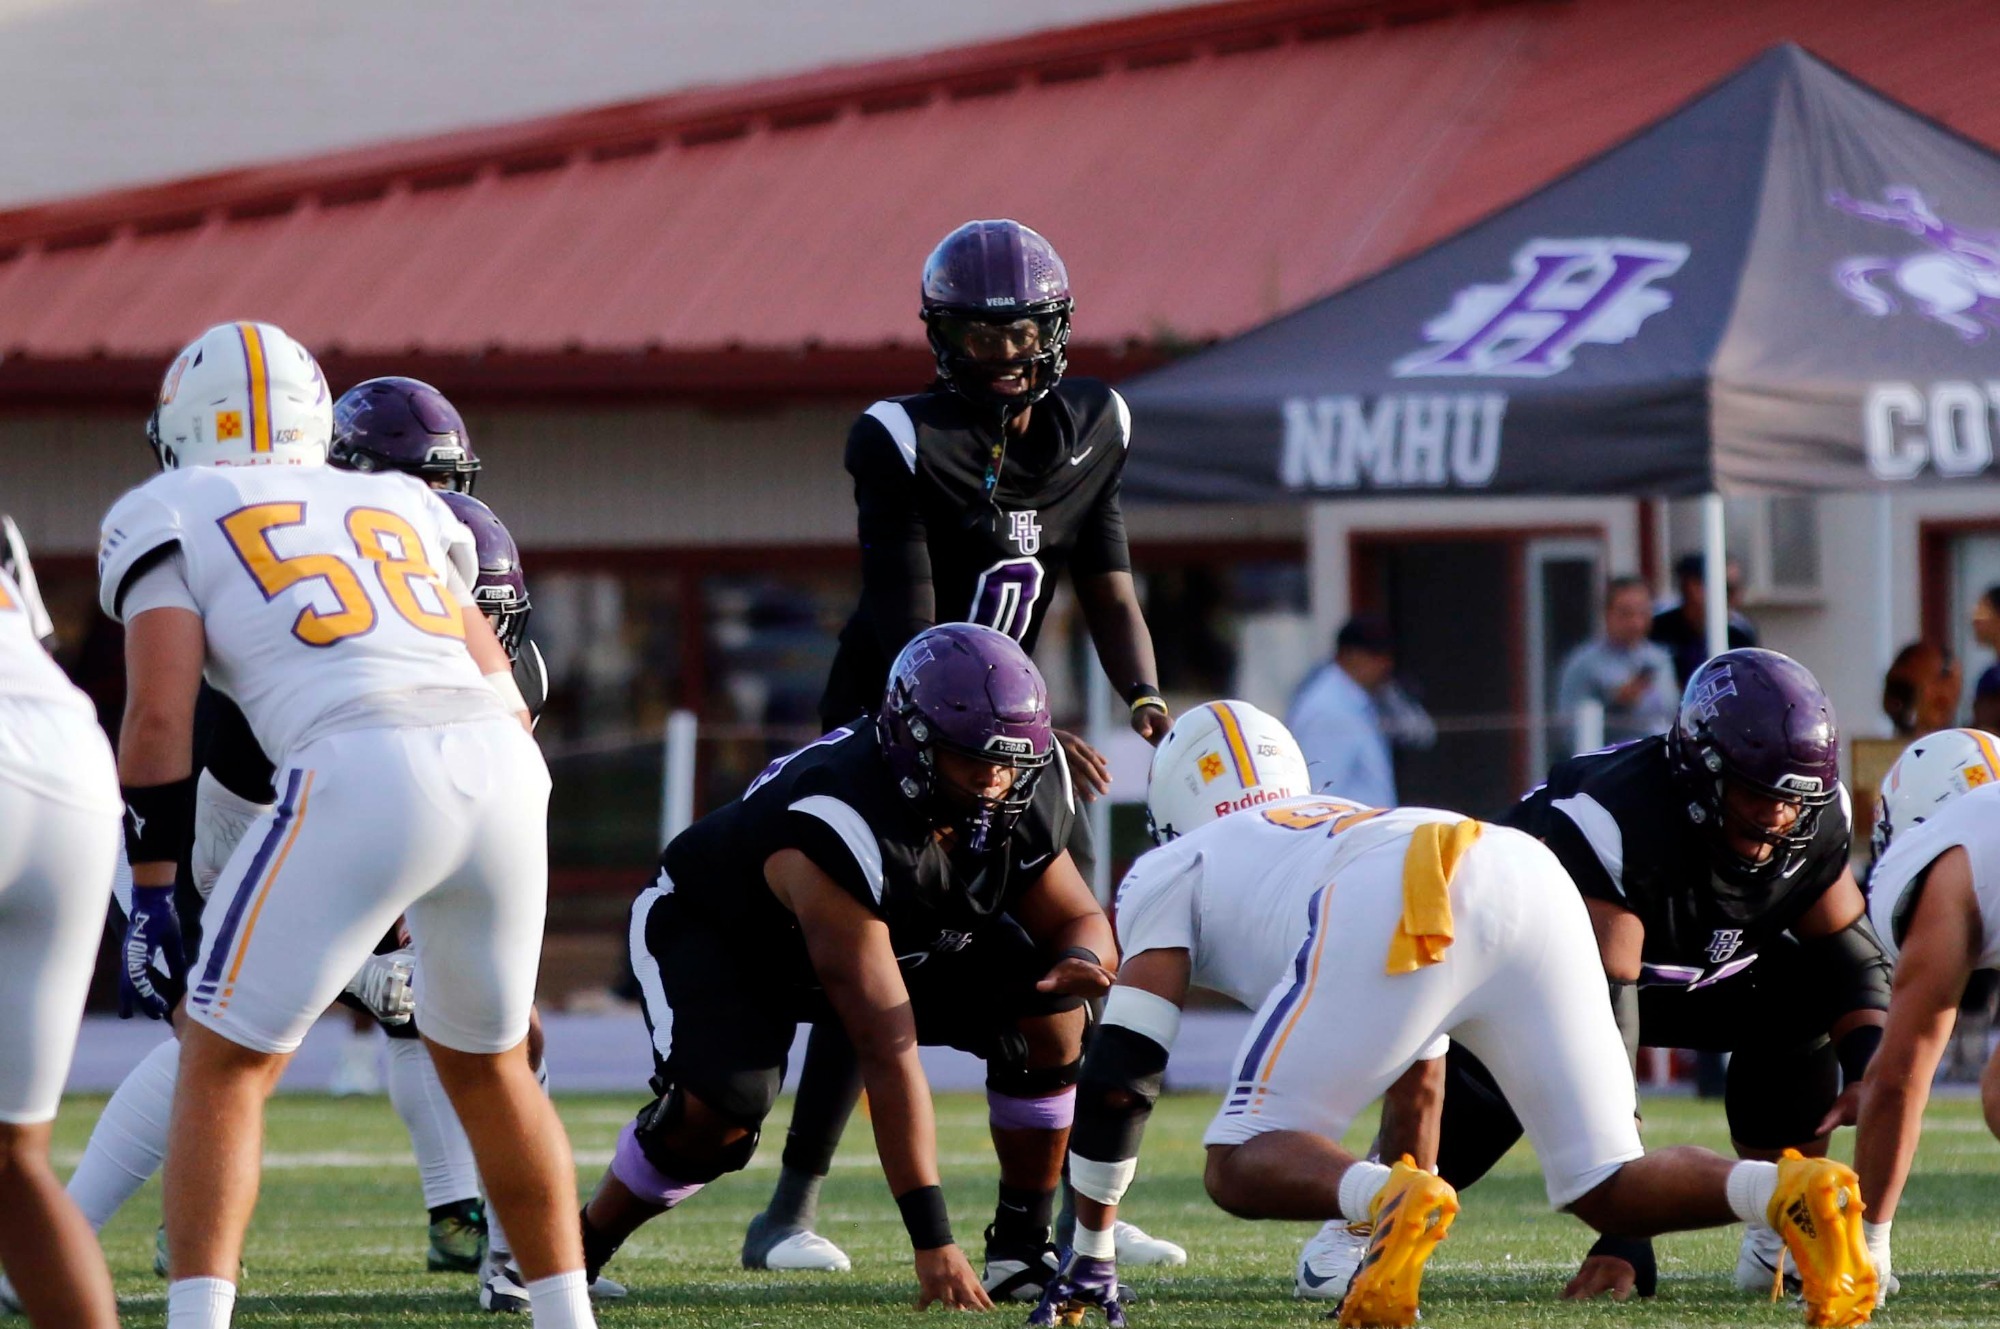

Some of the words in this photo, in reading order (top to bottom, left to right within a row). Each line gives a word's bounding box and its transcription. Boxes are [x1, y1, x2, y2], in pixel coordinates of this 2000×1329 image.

[986, 296, 1016, 306] VEGAS
[1392, 238, 1690, 377] H
[1281, 393, 1508, 489] NMHU
[1864, 381, 2000, 480] CO
[1008, 511, 1042, 555] HU
[215, 500, 467, 648] 58
[1000, 741, 1027, 753] VEGAS
[1215, 787, 1291, 818] Riddell
[1790, 779, 1817, 791] VEGAS
[1704, 929, 1744, 963] HU
